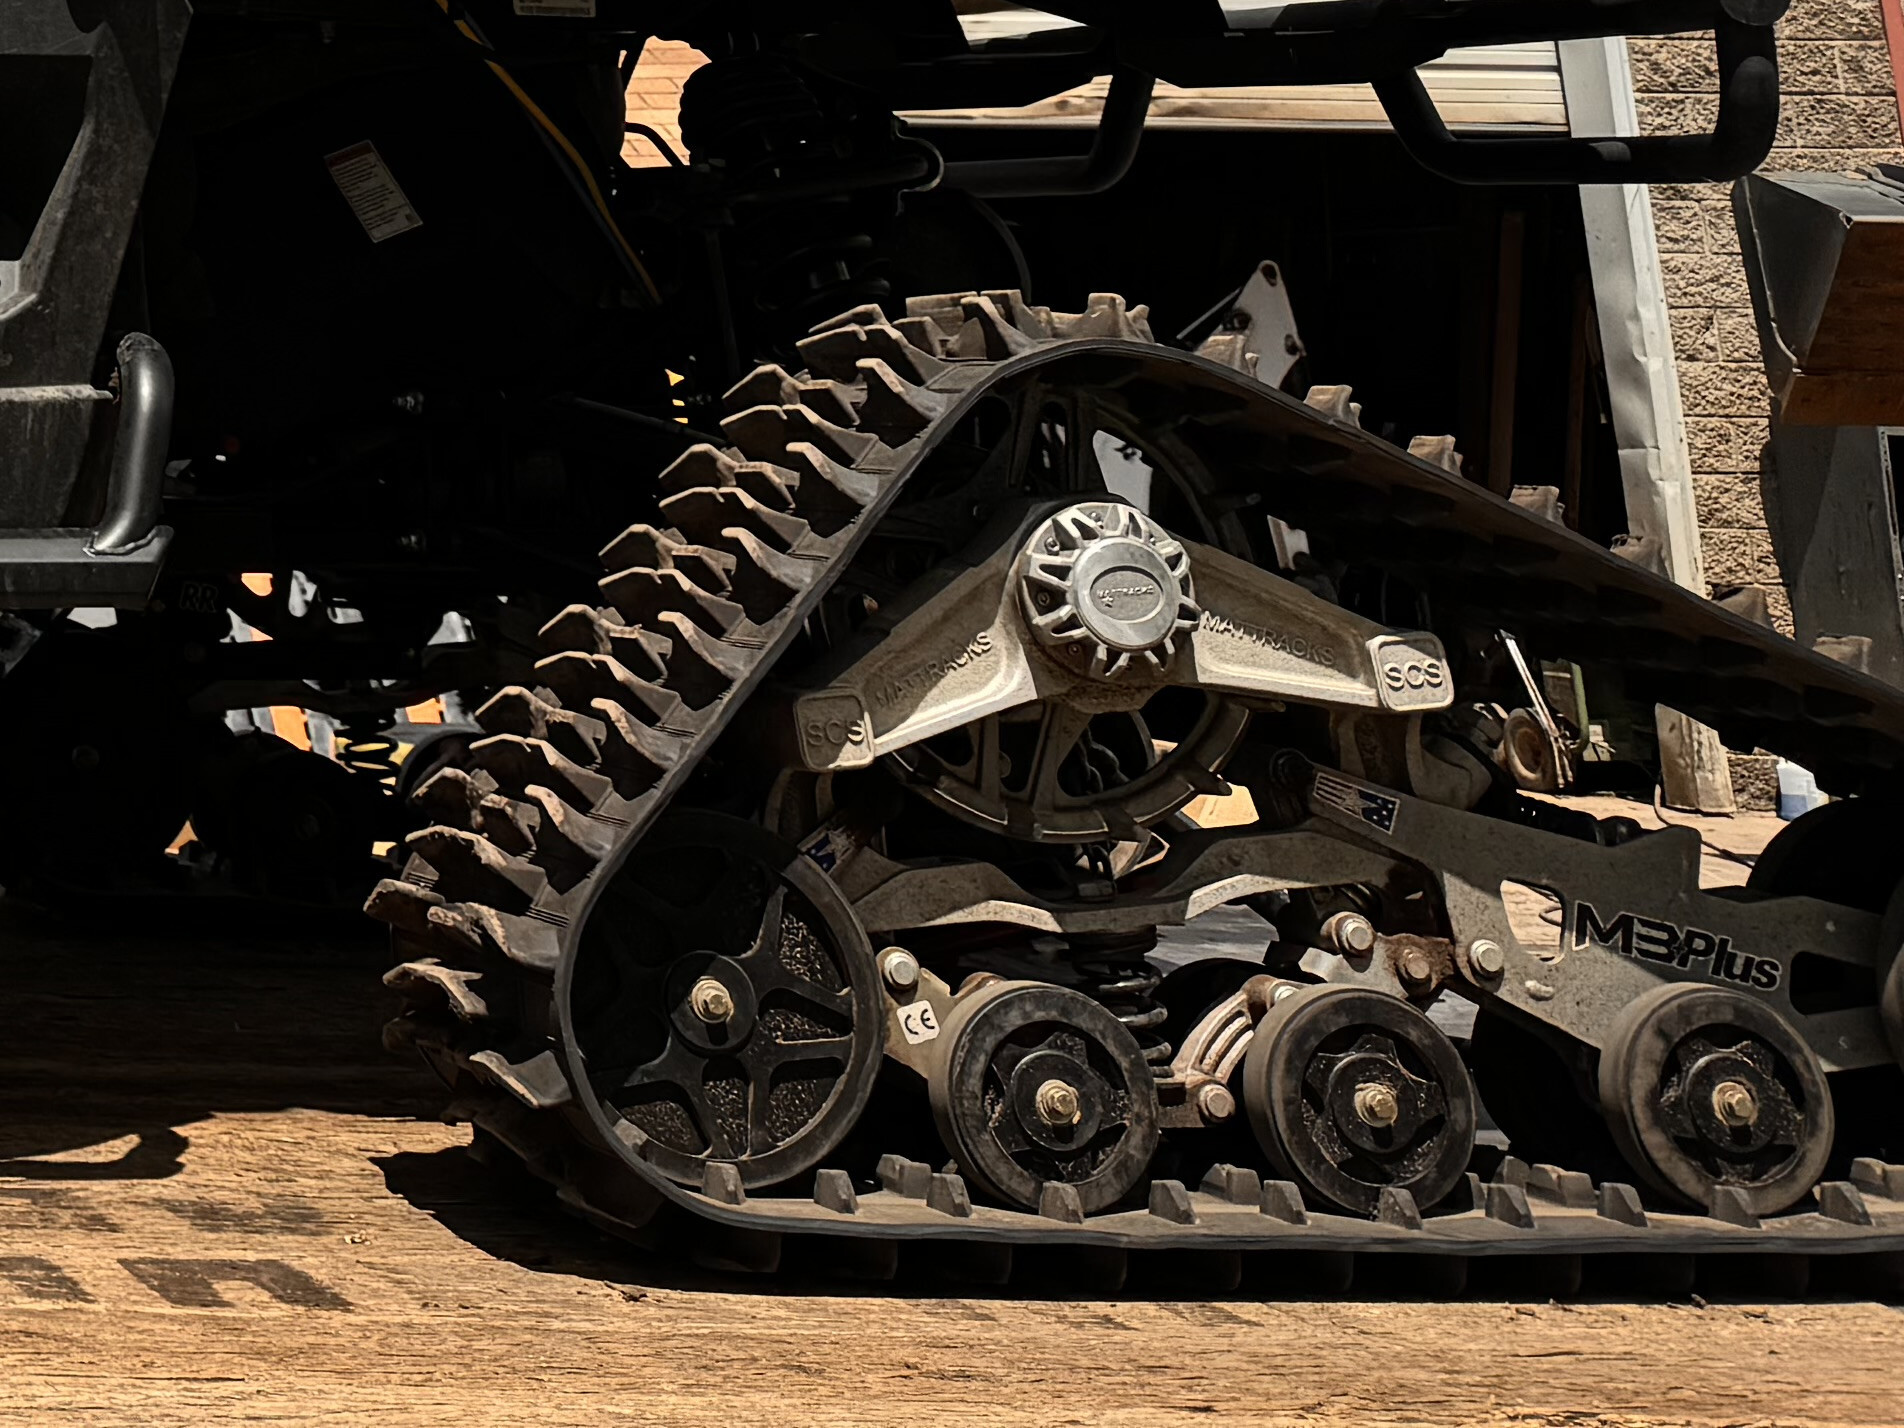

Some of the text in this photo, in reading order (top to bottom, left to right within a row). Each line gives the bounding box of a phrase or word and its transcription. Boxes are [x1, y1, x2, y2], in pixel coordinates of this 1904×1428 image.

[1200, 610, 1336, 666] MATTRACKS
[875, 631, 993, 708] MATTRACKS
[1383, 658, 1444, 692] SCS
[806, 719, 866, 746] SCS
[904, 1008, 935, 1035] CE
